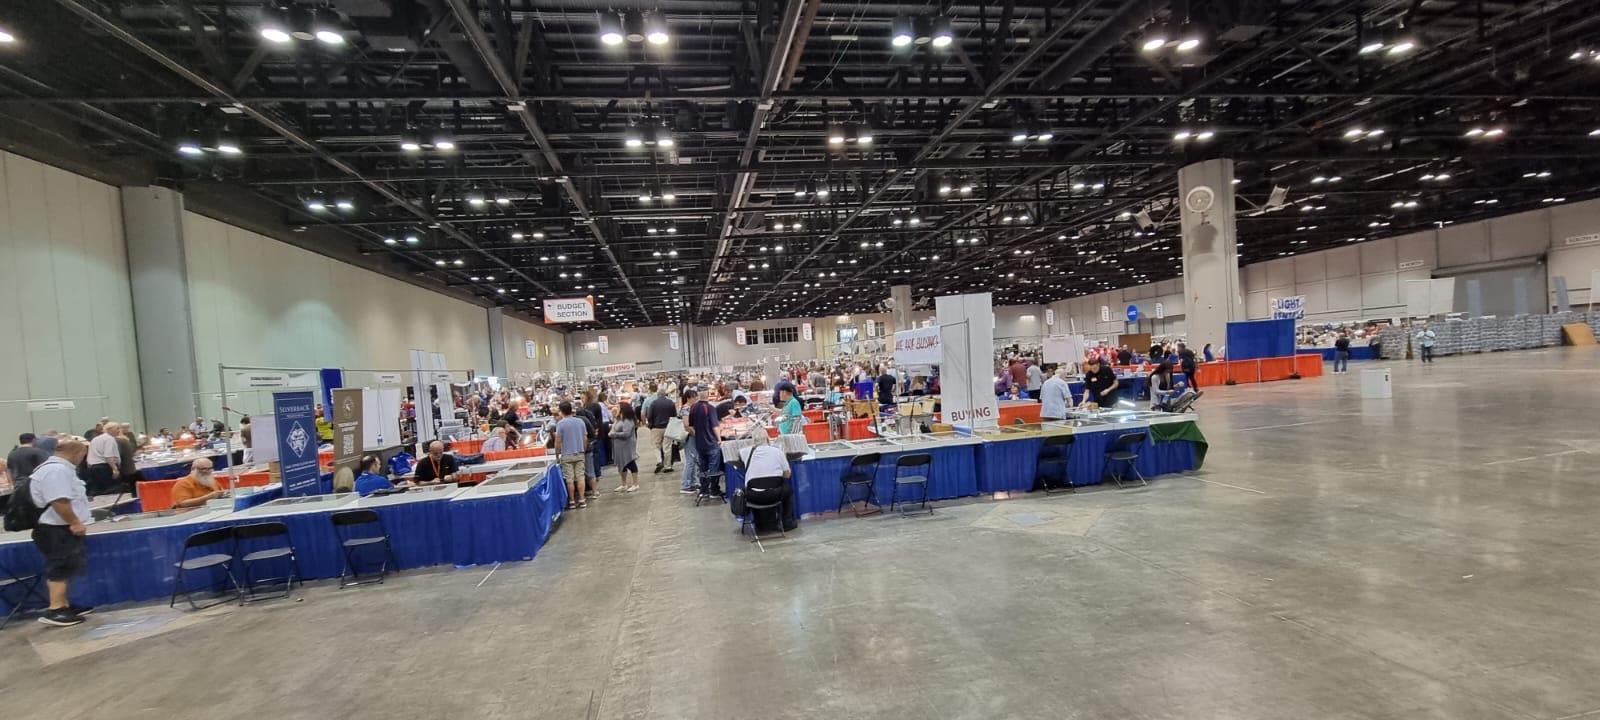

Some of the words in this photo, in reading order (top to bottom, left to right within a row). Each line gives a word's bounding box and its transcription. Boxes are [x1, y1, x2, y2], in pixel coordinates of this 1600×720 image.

[557, 302, 586, 310] BUDGET
[1277, 298, 1299, 309] LIGHT
[905, 338, 913, 350] ARE
[916, 335, 939, 349] BUYING
[606, 364, 630, 373] BUYING
[951, 406, 991, 422] BUYING
